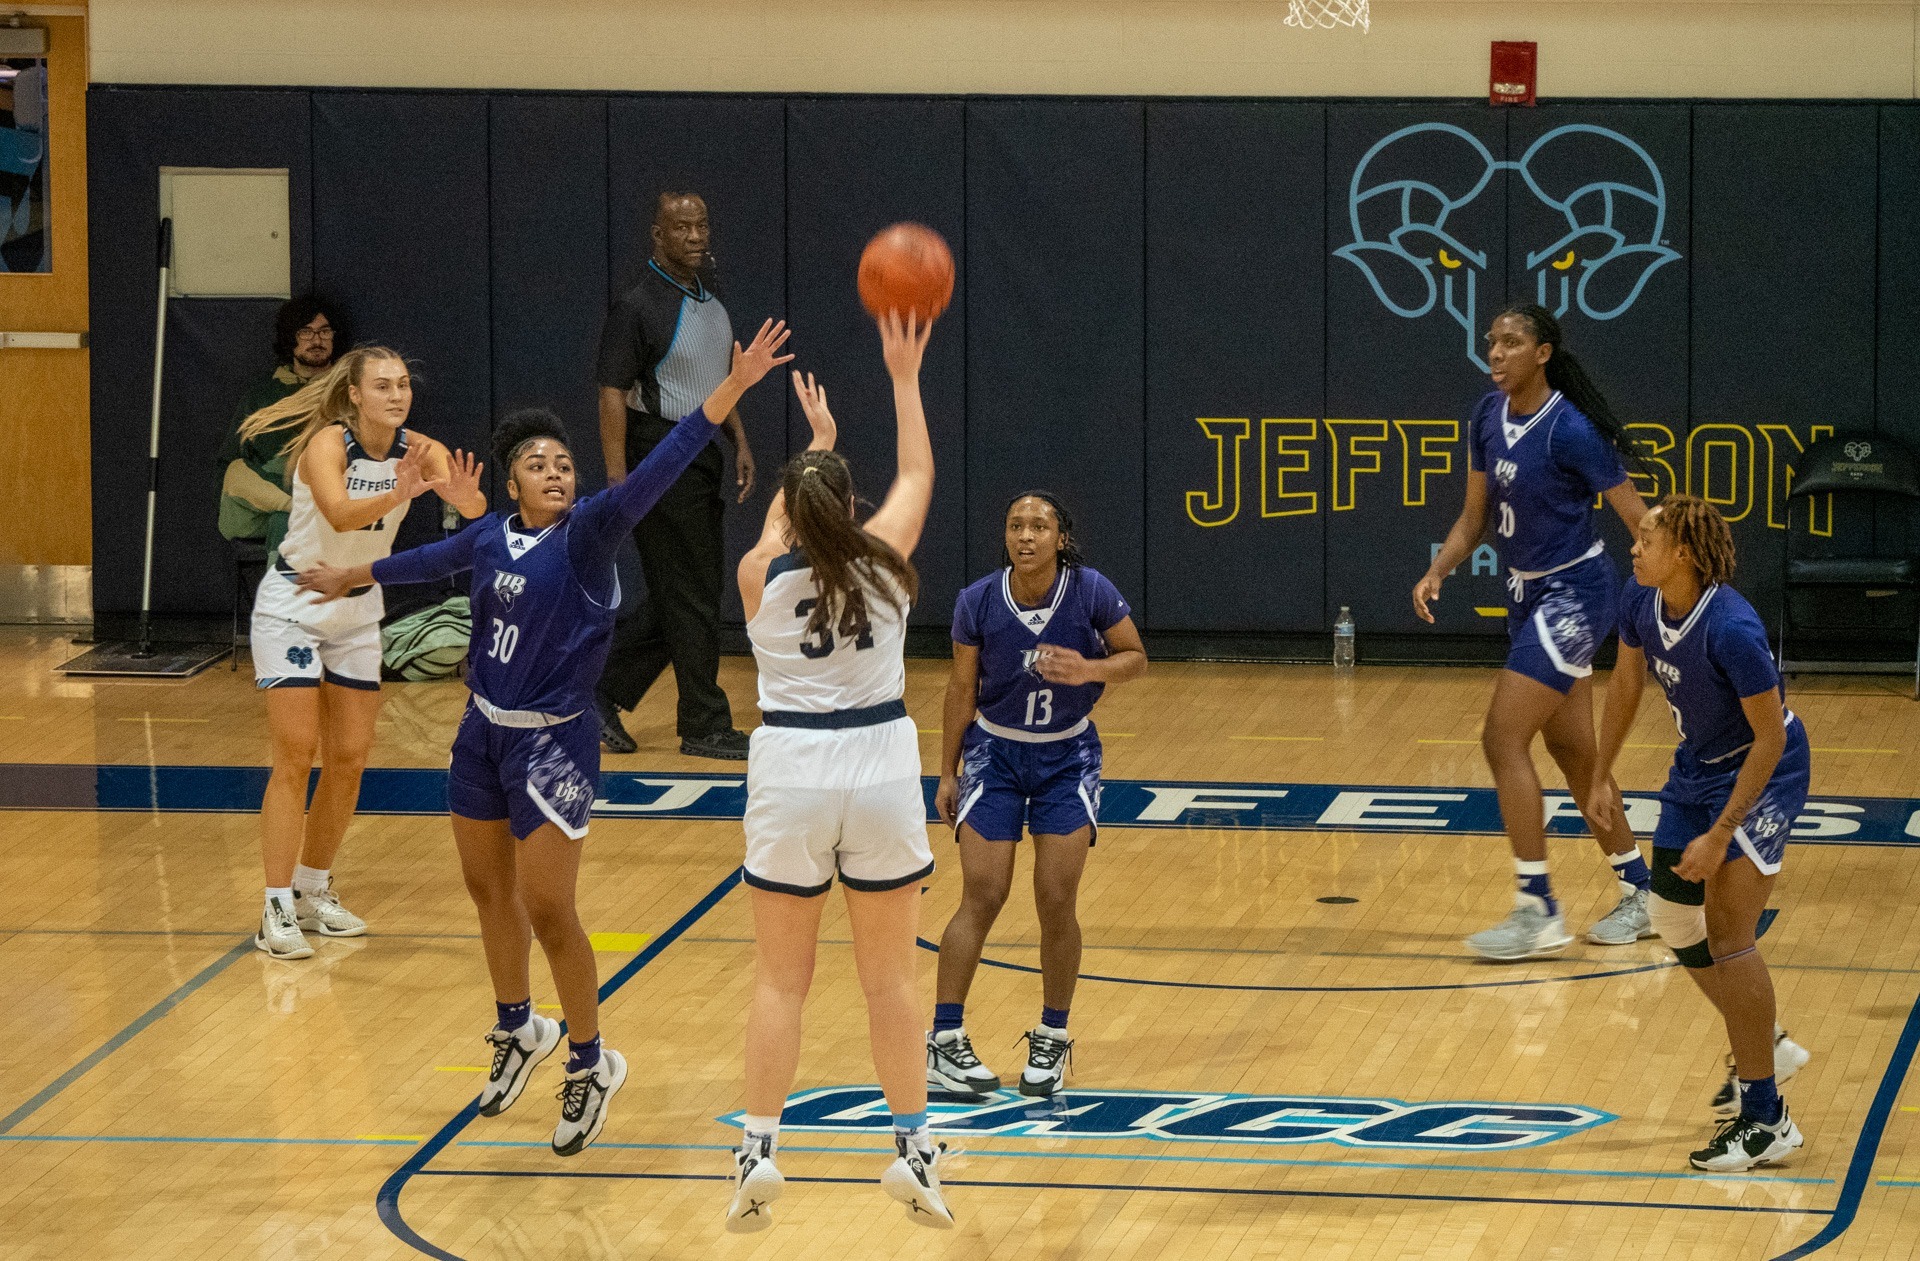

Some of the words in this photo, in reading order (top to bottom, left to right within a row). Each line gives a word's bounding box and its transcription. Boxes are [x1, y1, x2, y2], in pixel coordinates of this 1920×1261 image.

[1185, 417, 1834, 537] JEFFSON
[493, 569, 527, 596] UB
[487, 617, 520, 664] 30
[794, 587, 875, 660] 34
[1024, 688, 1054, 726] 13
[555, 781, 579, 803] UB
[1755, 816, 1780, 838] UB
